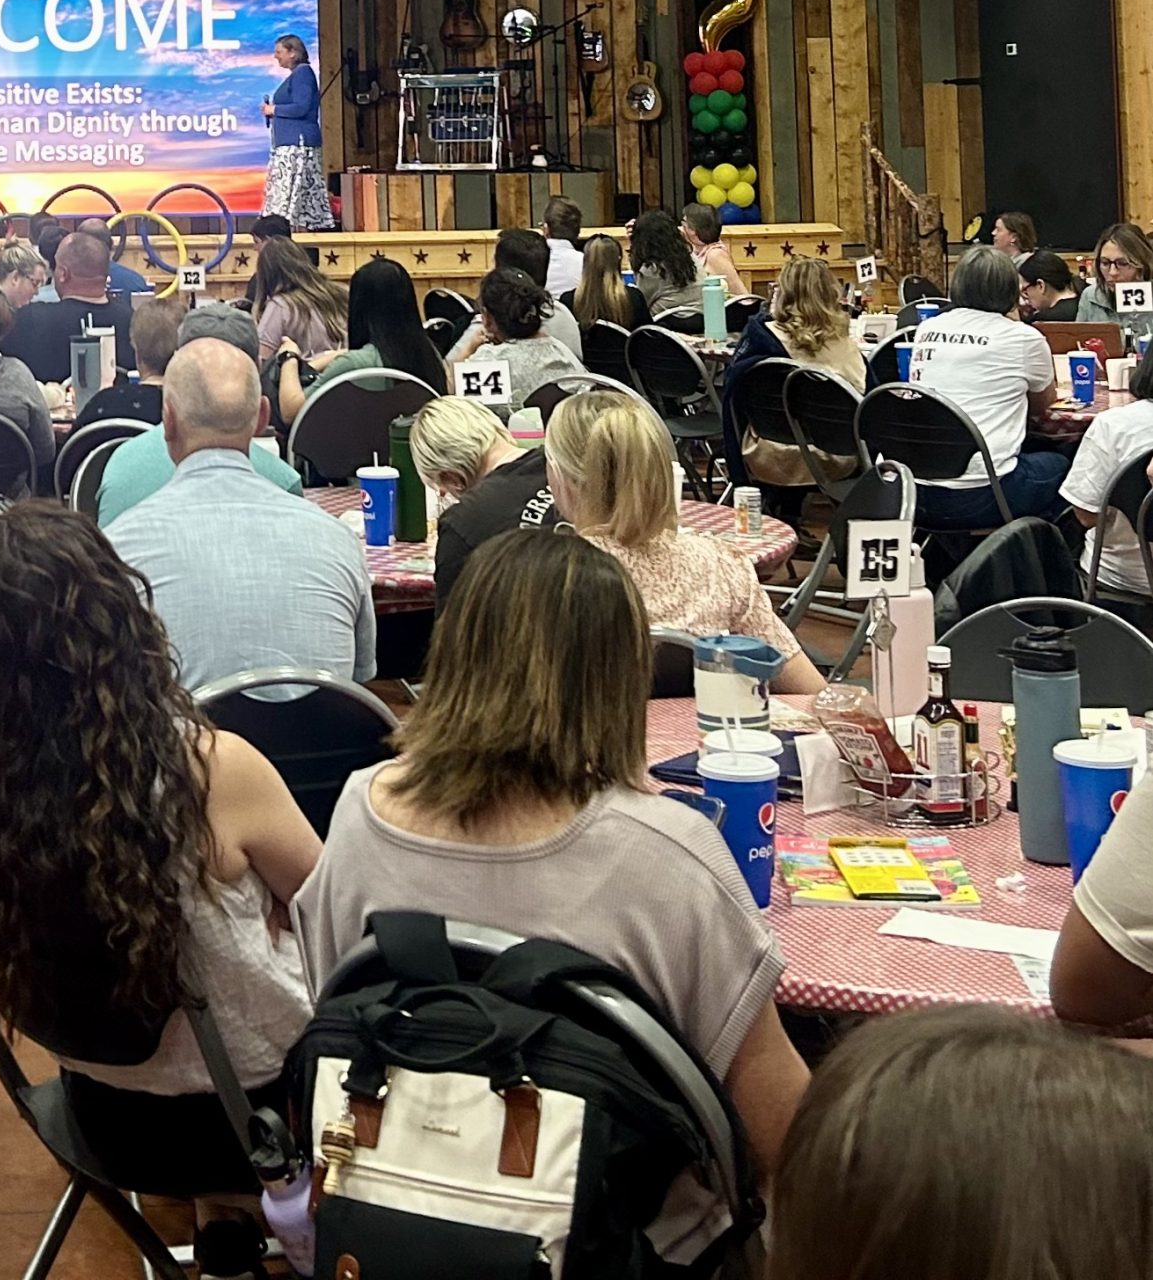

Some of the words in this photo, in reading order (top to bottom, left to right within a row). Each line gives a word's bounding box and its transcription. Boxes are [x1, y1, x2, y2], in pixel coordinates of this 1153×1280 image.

[66, 82, 144, 106] Exists:
[48, 110, 136, 139] Dignity
[141, 109, 238, 137] through
[15, 140, 146, 166] Messaging
[183, 271, 200, 285] E2
[1122, 288, 1145, 306] F3
[462, 370, 504, 397] E4
[859, 538, 899, 582] E5
[748, 844, 773, 863] pep
